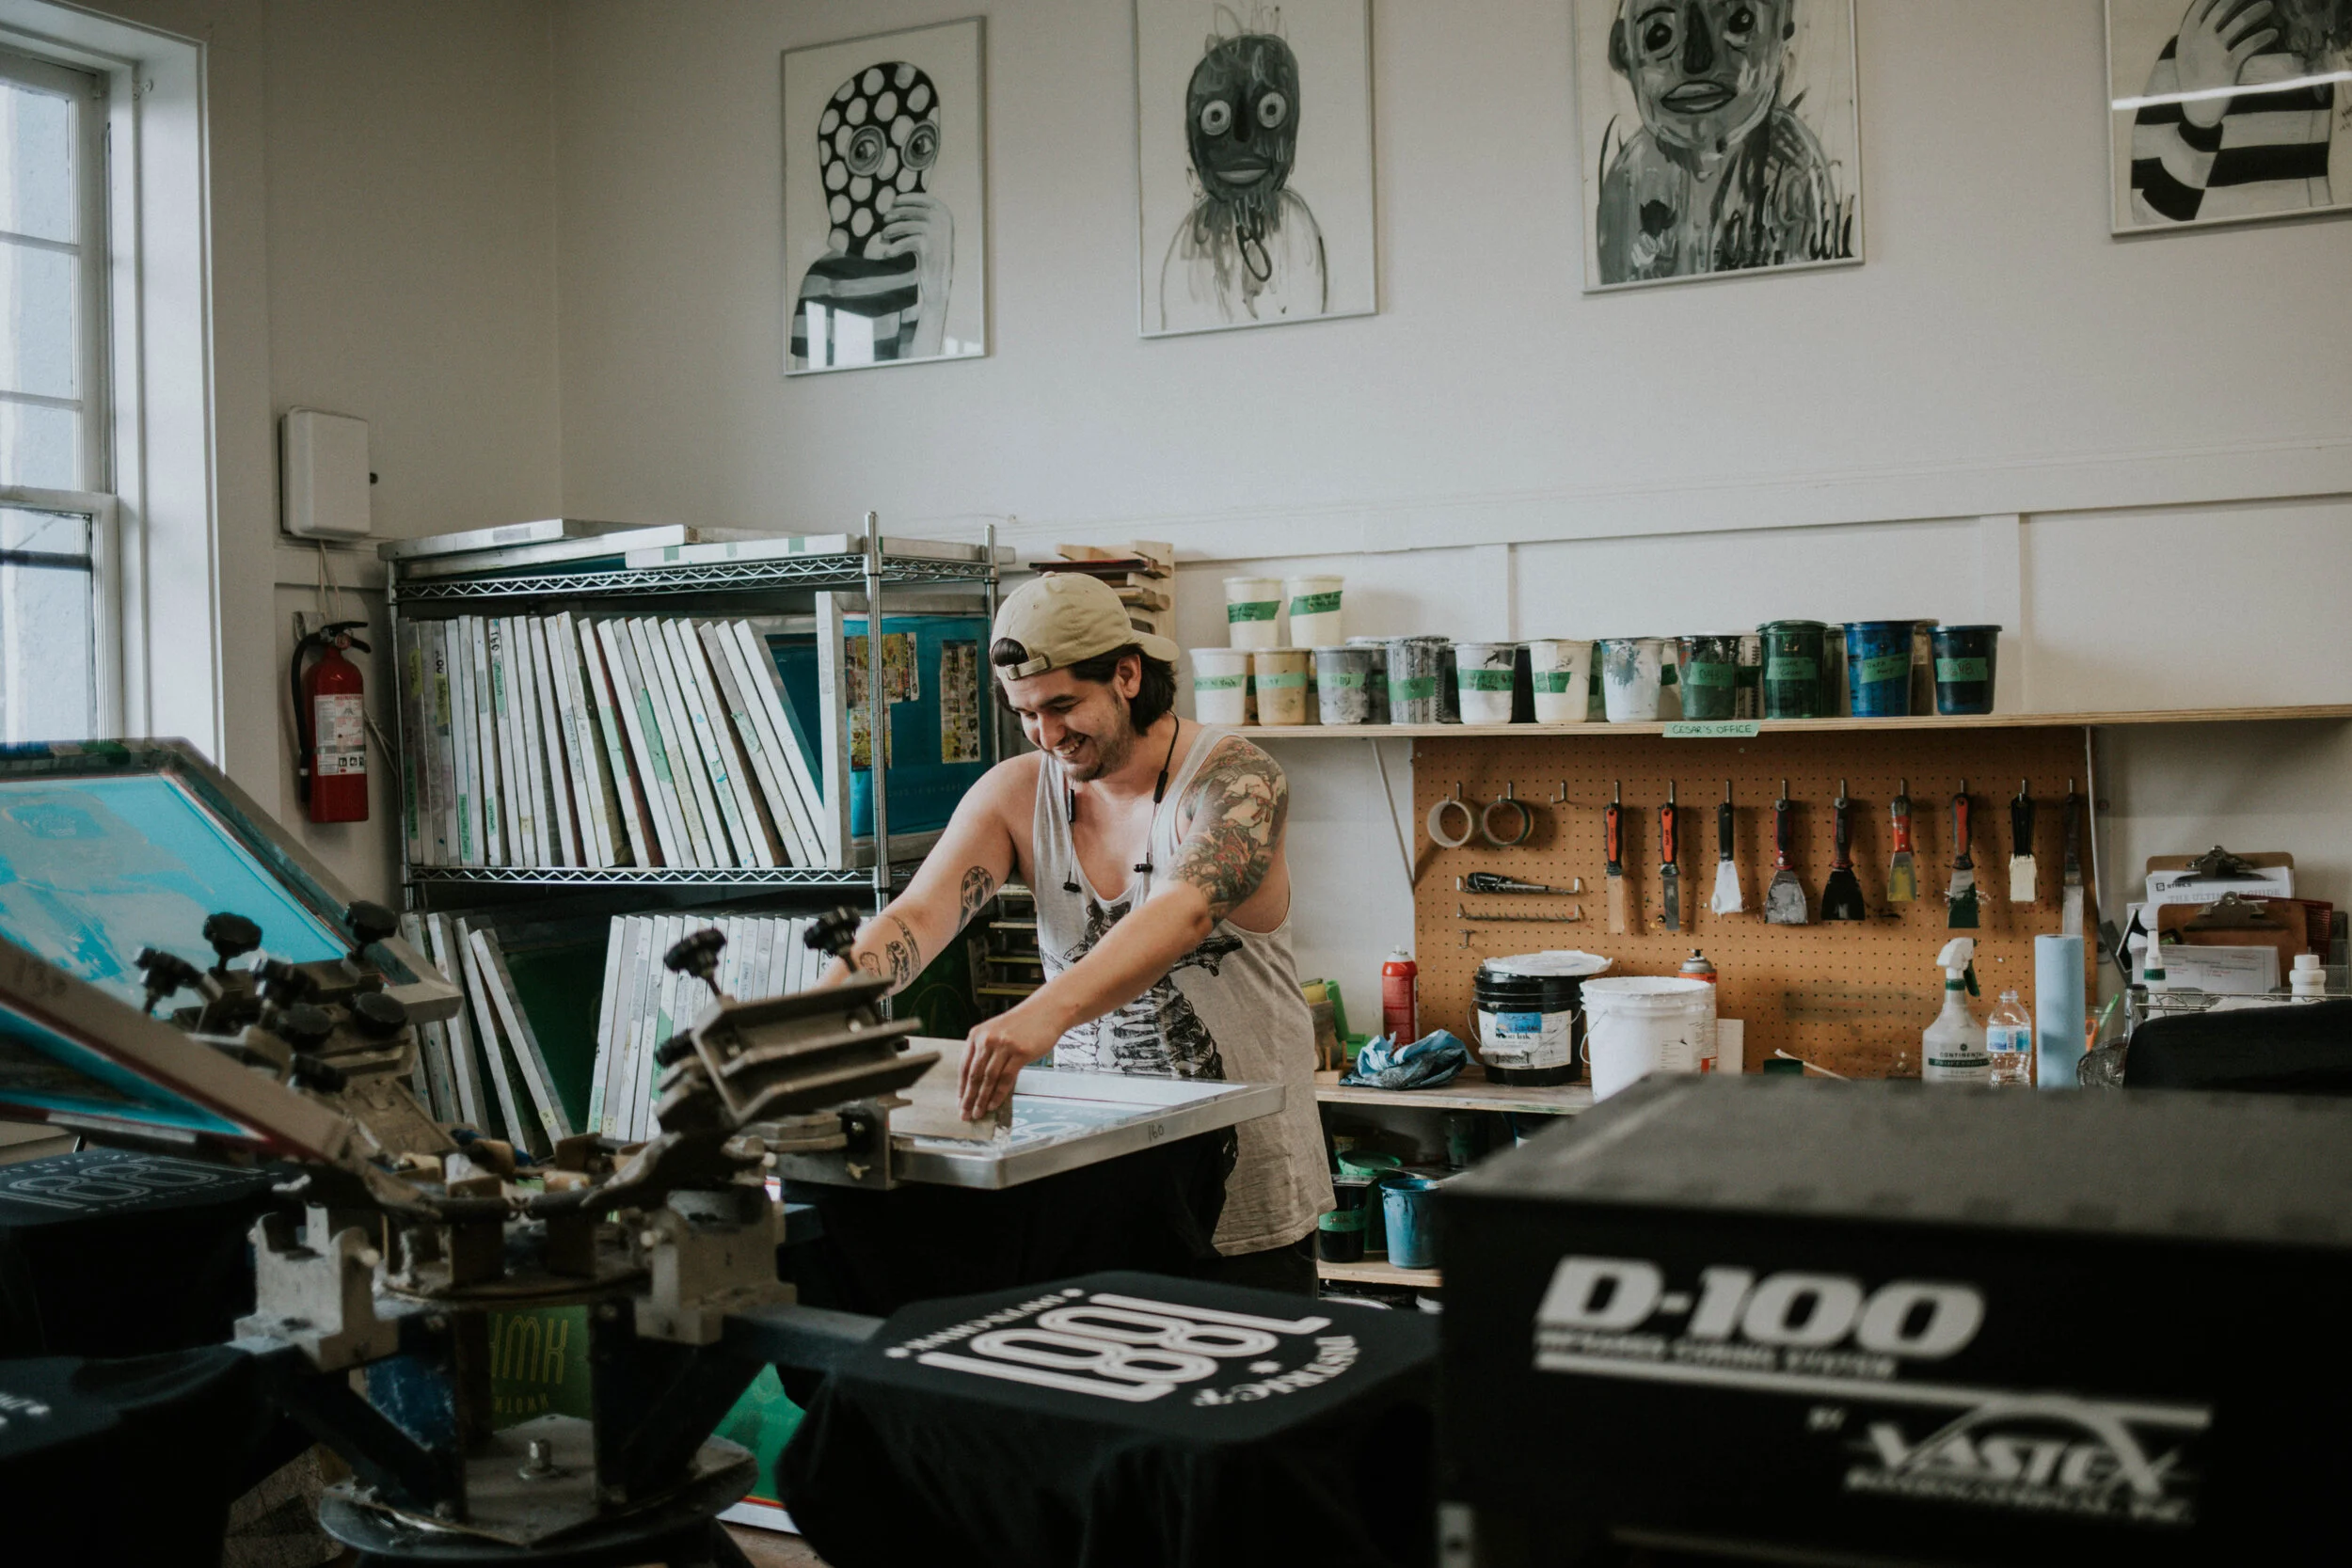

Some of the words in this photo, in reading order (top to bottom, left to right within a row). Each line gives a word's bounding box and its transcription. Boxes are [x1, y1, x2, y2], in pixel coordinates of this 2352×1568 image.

[1671, 723, 1712, 736] CESAR'S
[1716, 723, 1753, 735] OFFICE
[1147, 1123, 1165, 1143] 160
[915, 1291, 1332, 1402] 1881
[1534, 1254, 1986, 1360] D-100
[1865, 1418, 2181, 1497] VASTEX
